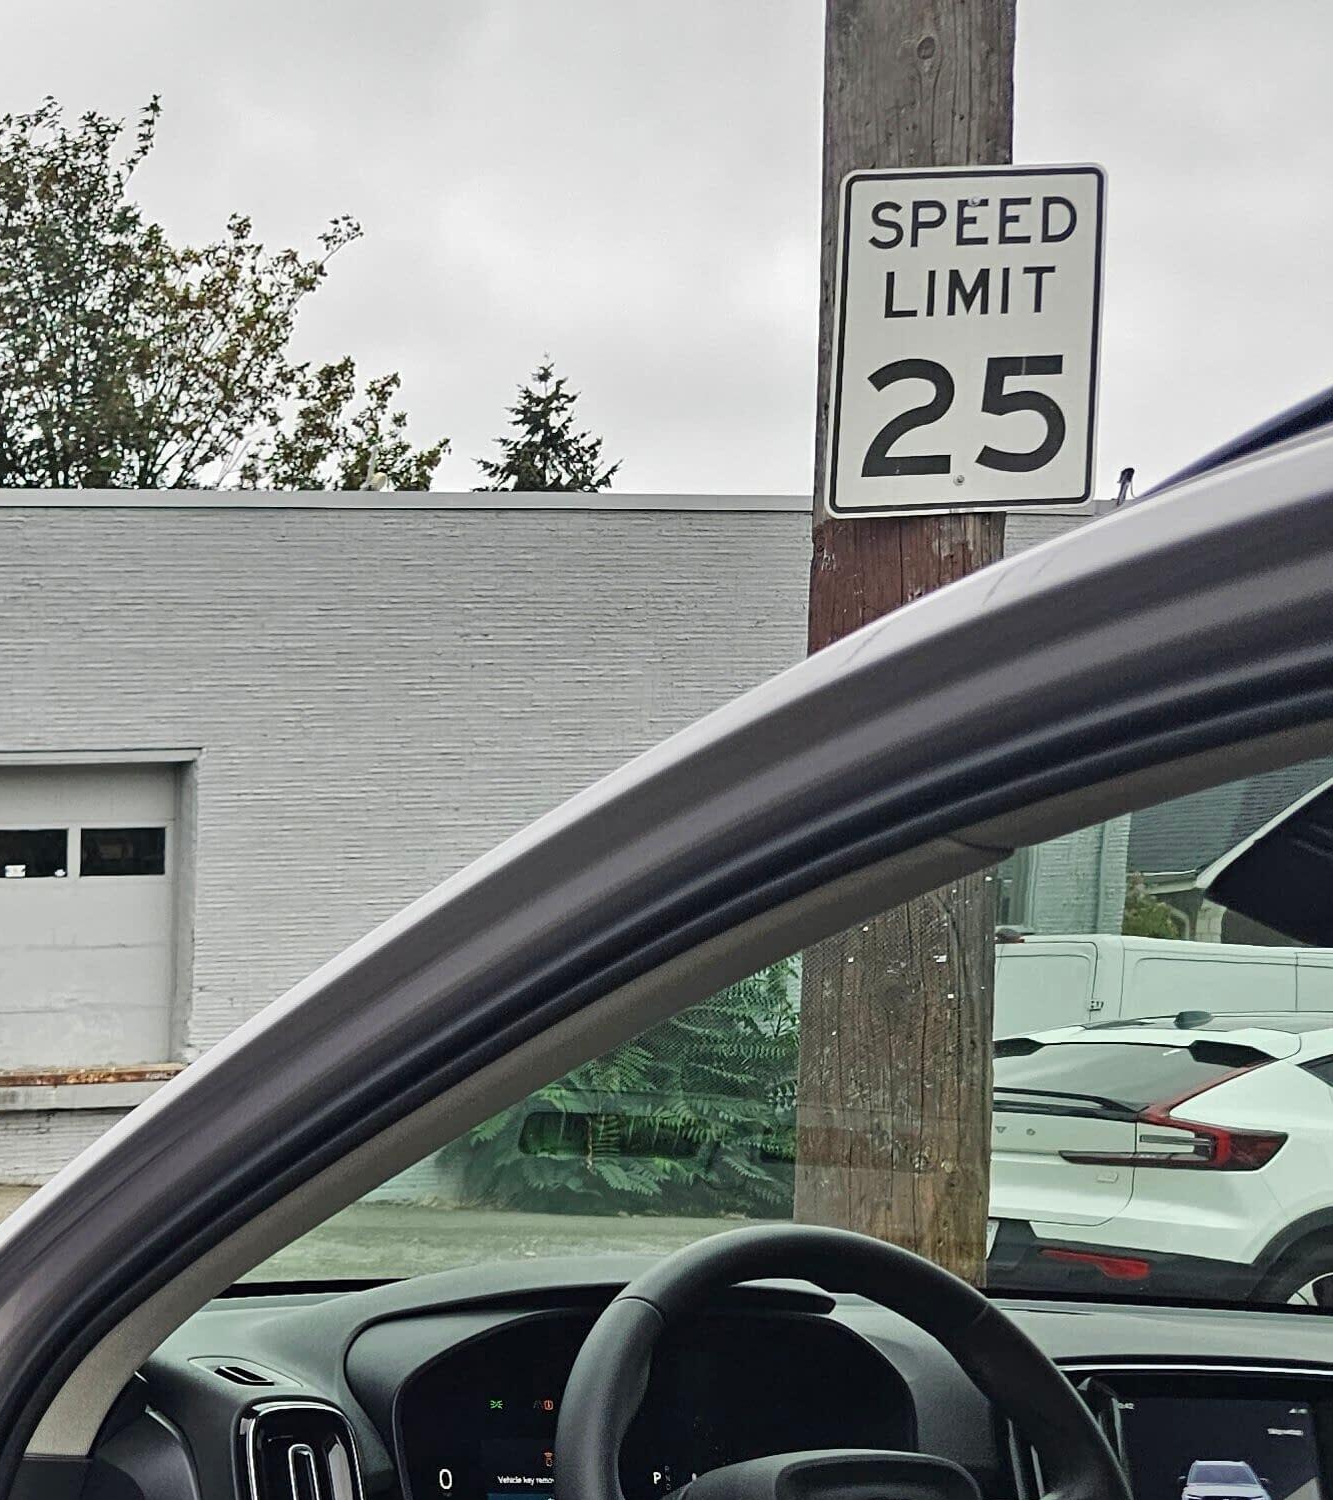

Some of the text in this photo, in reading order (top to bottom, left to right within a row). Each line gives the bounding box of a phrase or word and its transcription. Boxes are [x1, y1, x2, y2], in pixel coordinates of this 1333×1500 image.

[868, 196, 1077, 250] SPEED
[884, 266, 1056, 319] LIMIT
[861, 354, 1066, 478] 25
[439, 1468, 453, 1490] 0
[653, 1472, 662, 1485] P
